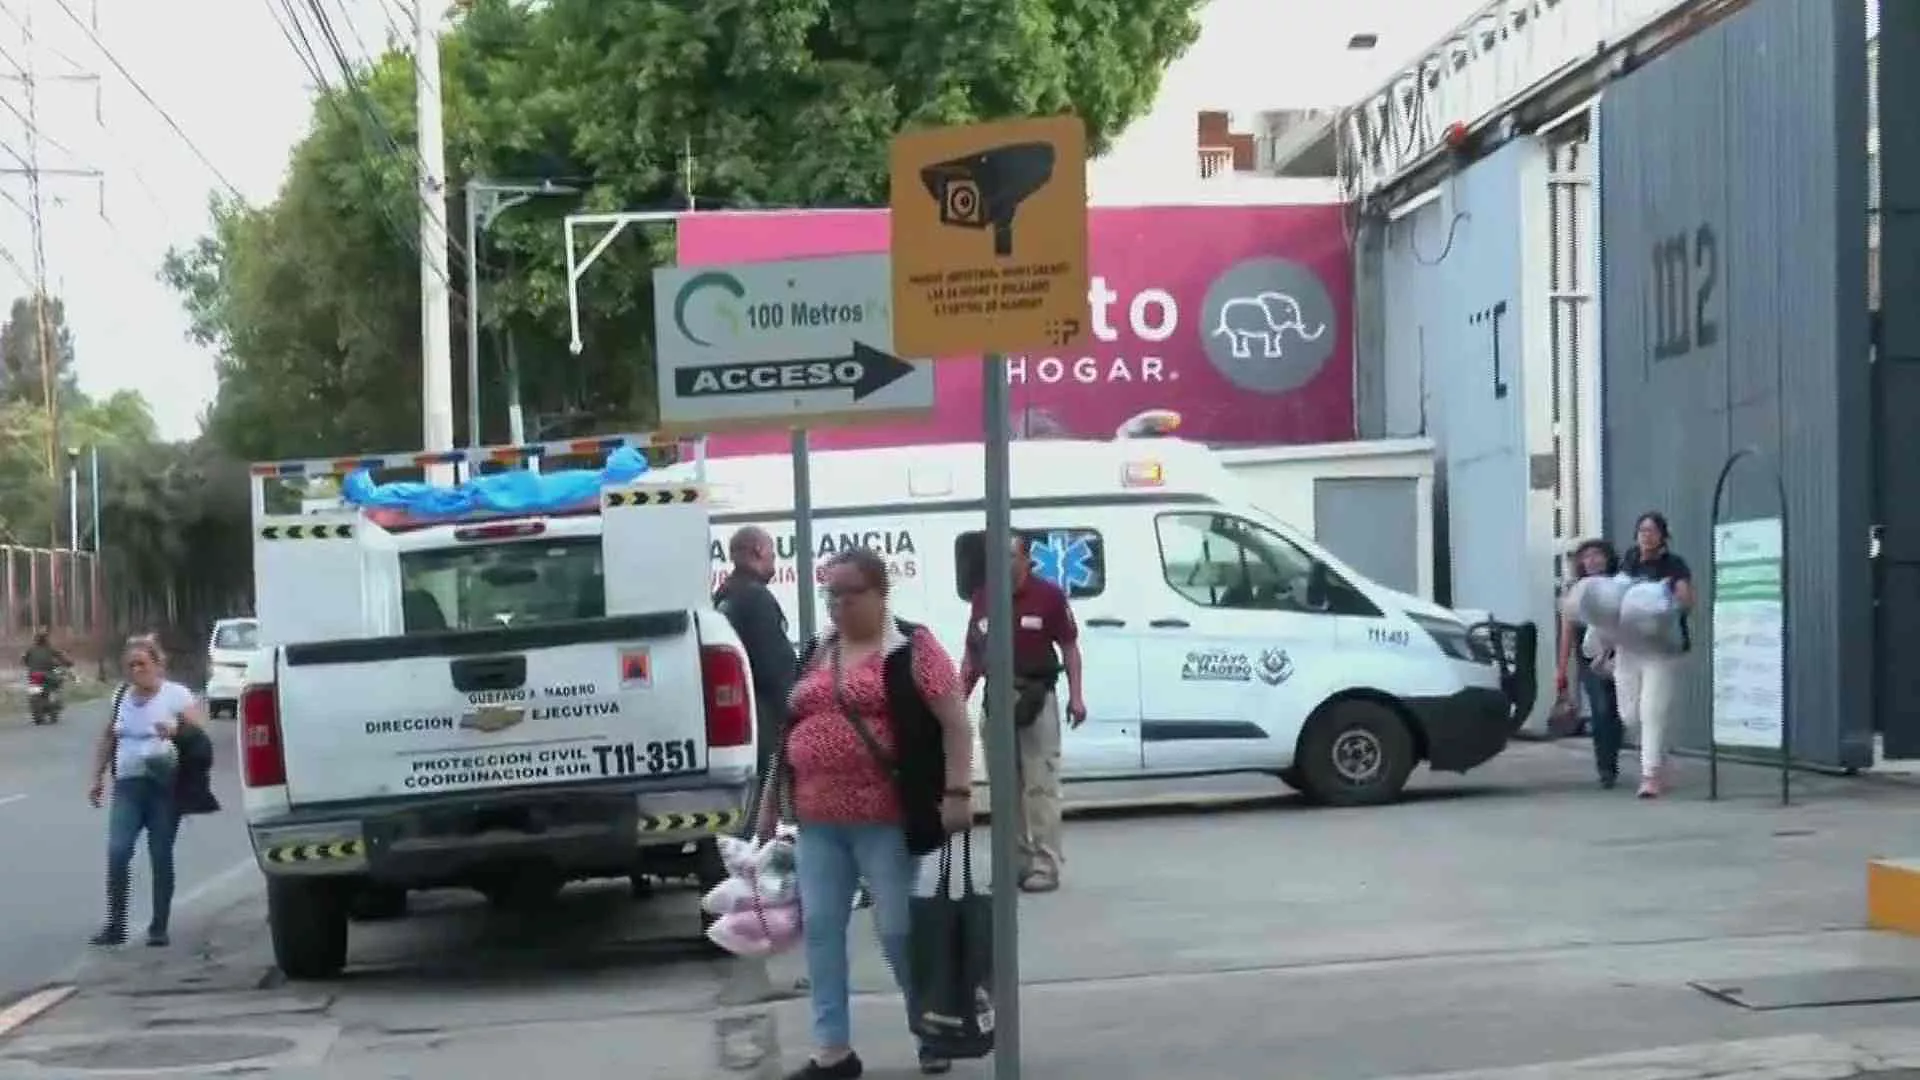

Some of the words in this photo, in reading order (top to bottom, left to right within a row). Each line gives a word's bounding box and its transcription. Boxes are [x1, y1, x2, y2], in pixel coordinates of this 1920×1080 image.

[747, 303, 784, 329] 100
[791, 299, 863, 327] Metros
[690, 360, 865, 393] ACCESO
[532, 701, 620, 721] EJECUTIVA
[539, 747, 587, 763] CIVIL
[593, 739, 697, 776] T11-351
[556, 763, 591, 777] SUR
